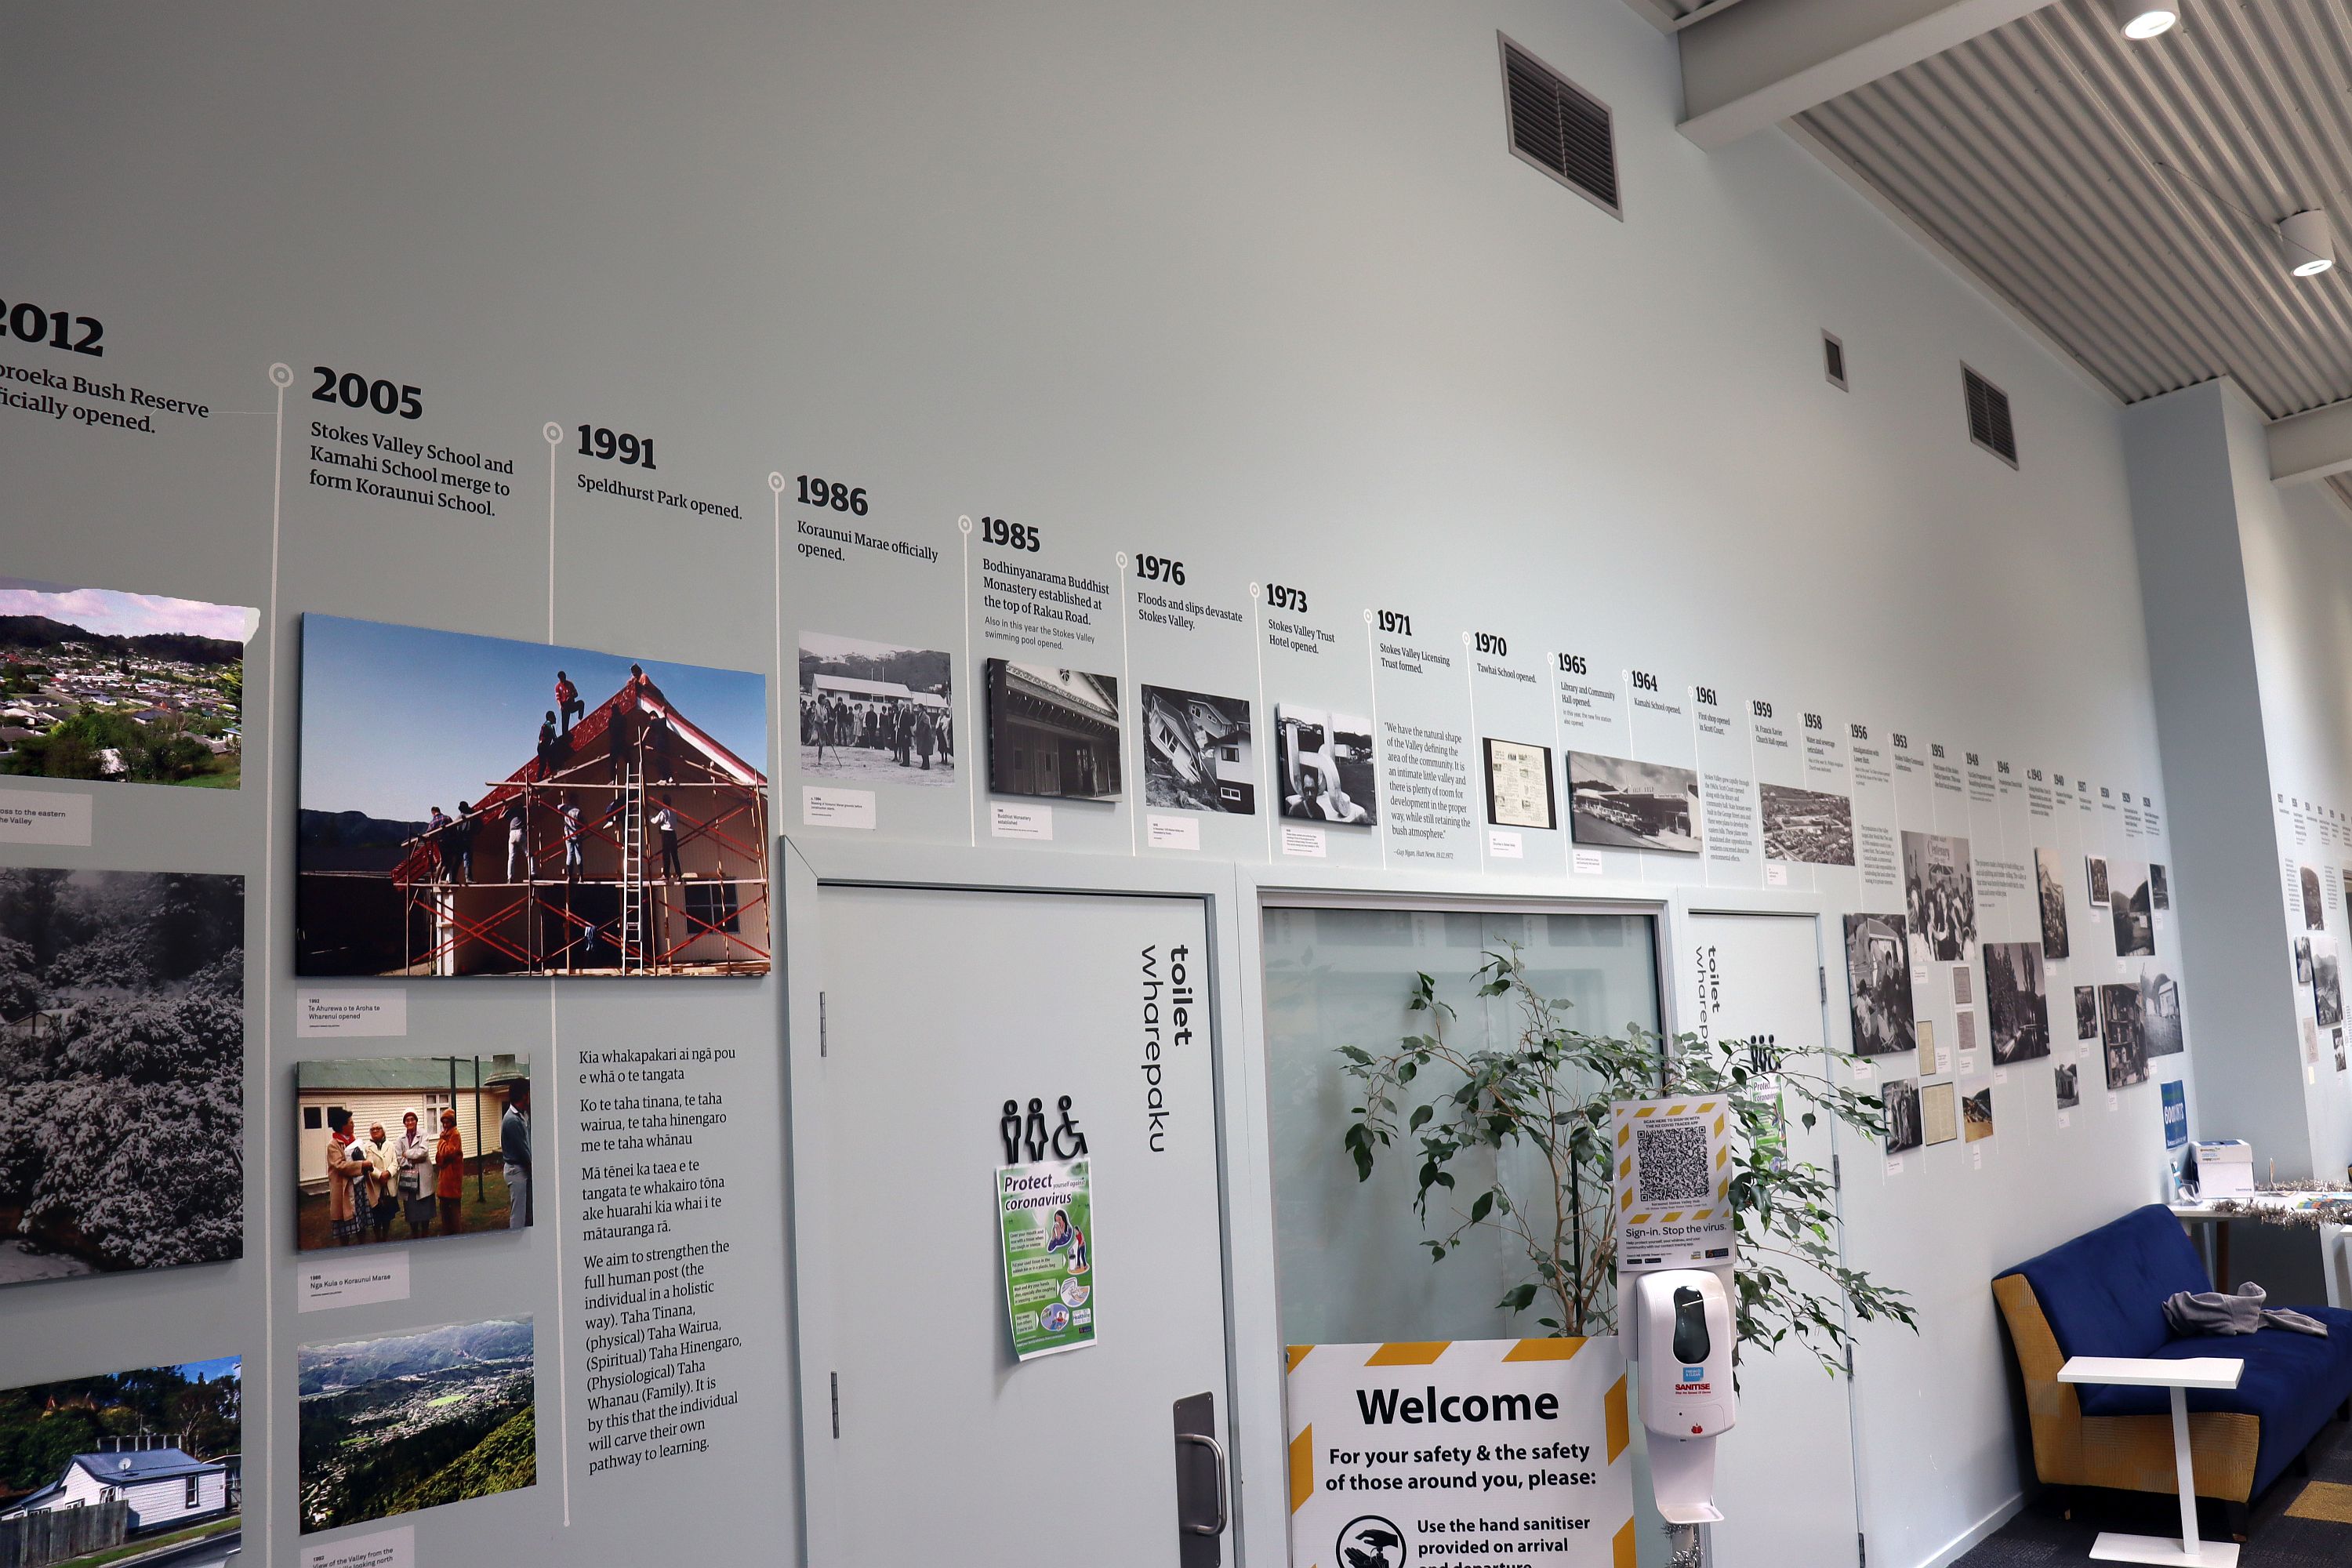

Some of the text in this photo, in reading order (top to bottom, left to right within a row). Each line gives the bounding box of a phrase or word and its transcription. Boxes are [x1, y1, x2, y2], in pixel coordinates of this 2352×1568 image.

[0, 299, 103, 358] 012
[72, 376, 125, 402] Bush
[129, 387, 209, 418] Reserve
[312, 366, 423, 419] 2005
[0, 387, 155, 434] icially opened.
[311, 422, 514, 474] Stokes Valley School and
[578, 424, 656, 470] 1991
[310, 445, 510, 496] Kamahi School merge to
[310, 469, 495, 517] form Koraunui School.
[578, 474, 742, 520] Speldhurst Park opened.
[797, 475, 868, 516] 1986
[797, 520, 938, 563] Koraunui Marae officially
[982, 517, 1040, 553] 1985
[798, 543, 845, 561] opened.
[983, 558, 1109, 595] Bodhinyanarama Buddhist
[1136, 554, 1185, 586] 1976
[983, 576, 1102, 610] Monastery established at
[1266, 583, 1308, 613] 1973
[984, 594, 1091, 625] the top of Rakau Road.
[1138, 592, 1243, 622] Floods and slips devastate
[985, 616, 1000, 626] Also
[1002, 619, 1008, 628] in
[1010, 620, 1022, 630] this
[1040, 626, 1051, 635] the
[1052, 628, 1075, 639] Stokes
[1076, 632, 1094, 644] Valley
[1138, 609, 1195, 631] Stokes Valley.
[1269, 619, 1335, 643] Stokes Valley Trust
[1377, 609, 1412, 636] 1971
[985, 630, 1063, 650] swimming pool opened.
[1269, 634, 1319, 654] Hotel opened.
[1475, 632, 1507, 656] 1970
[1380, 643, 1450, 667] Stokes Valley Licensing
[1381, 657, 1423, 673] Trust formed.
[1559, 652, 1587, 675] 1965
[1477, 662, 1537, 683] Tawhai School opened.
[1632, 670, 1657, 692] 1964
[1560, 681, 1615, 702] Library and Community
[1562, 694, 1592, 707] Hall opened.
[1696, 686, 1717, 706] 1961
[1634, 697, 1650, 708] Kamahi
[1651, 701, 1665, 711] School
[1753, 700, 1772, 718] 1959
[1698, 712, 1708, 720] First
[1708, 714, 1716, 724] shop
[1704, 724, 1713, 733] Scott
[1804, 713, 1822, 730] 1958
[1397, 723, 1412, 735] have
[1413, 726, 1423, 737] the
[1424, 731, 1444, 740] natural
[1445, 731, 1461, 745] shape
[1851, 724, 1867, 740] 1956
[1893, 733, 1907, 749] 1953
[1931, 743, 1944, 758] 1951
[1965, 752, 1979, 766] 1948
[1997, 760, 2009, 774] 1946
[1392, 824, 1407, 836] bush
[1708, 946, 1720, 1014] toilet
[1171, 945, 1193, 1047] toilet
[579, 1047, 735, 1065] Kia whakapakari ai ngā pou
[1141, 945, 1170, 1152] wharepaku
[1004, 1174, 1085, 1192] Protect yourself against
[1006, 1192, 1071, 1210] coronavirus
[1626, 1223, 1726, 1239] Sign-in. Stop the virus.
[583, 1240, 729, 1269] We aim to strengthen the
[344, 1276, 371, 1285] Koraunui
[1356, 1386, 1559, 1425] Welcome
[1330, 1442, 1590, 1468] For your safety & the safety
[1326, 1469, 1596, 1492] of those around you, please:
[1417, 1516, 1590, 1533] Use the hand sanitiser
[1418, 1537, 1568, 1558] provided on arrival
